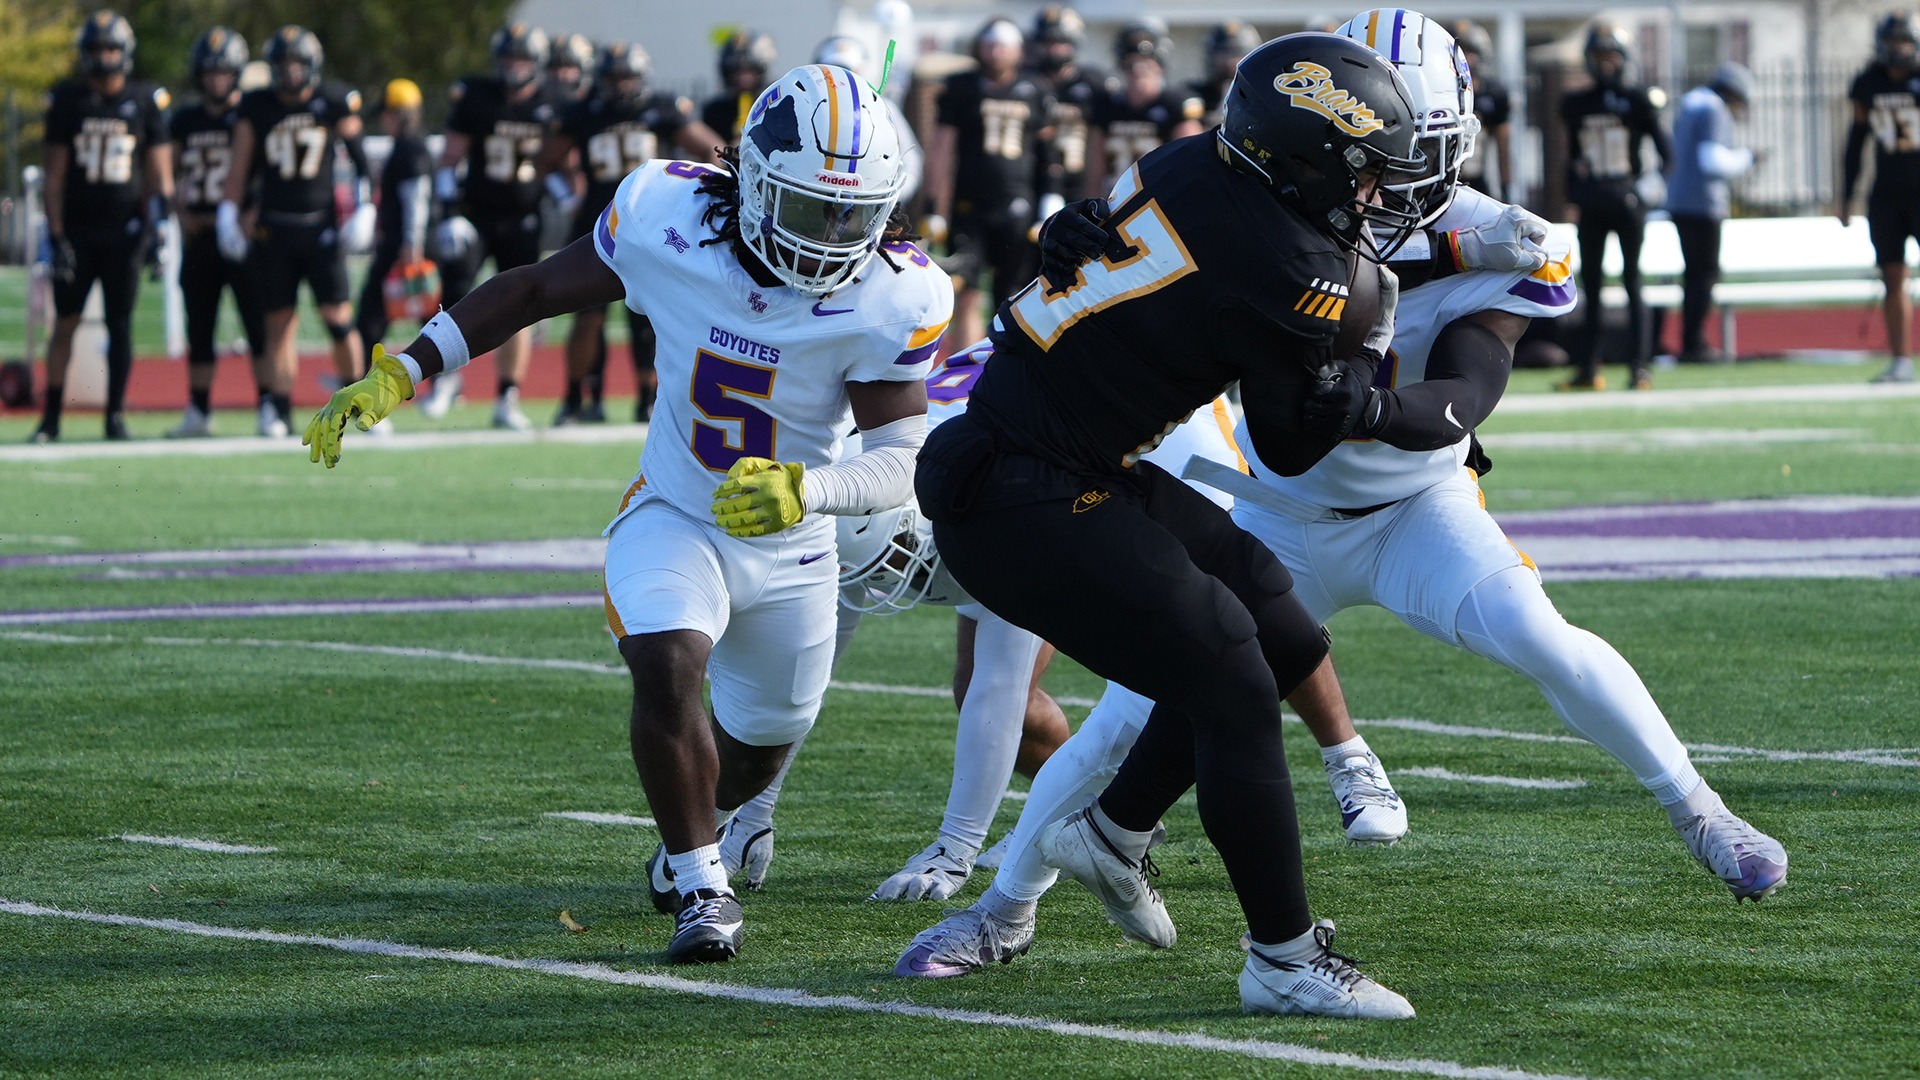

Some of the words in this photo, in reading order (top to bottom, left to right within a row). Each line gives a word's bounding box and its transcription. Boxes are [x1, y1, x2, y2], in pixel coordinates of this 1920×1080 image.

[752, 85, 782, 124] 5
[1273, 61, 1384, 137] Braves
[818, 174, 859, 186] Riddell
[1009, 160, 1200, 354] 3
[709, 326, 781, 365] COYOTES
[689, 347, 777, 474] 5
